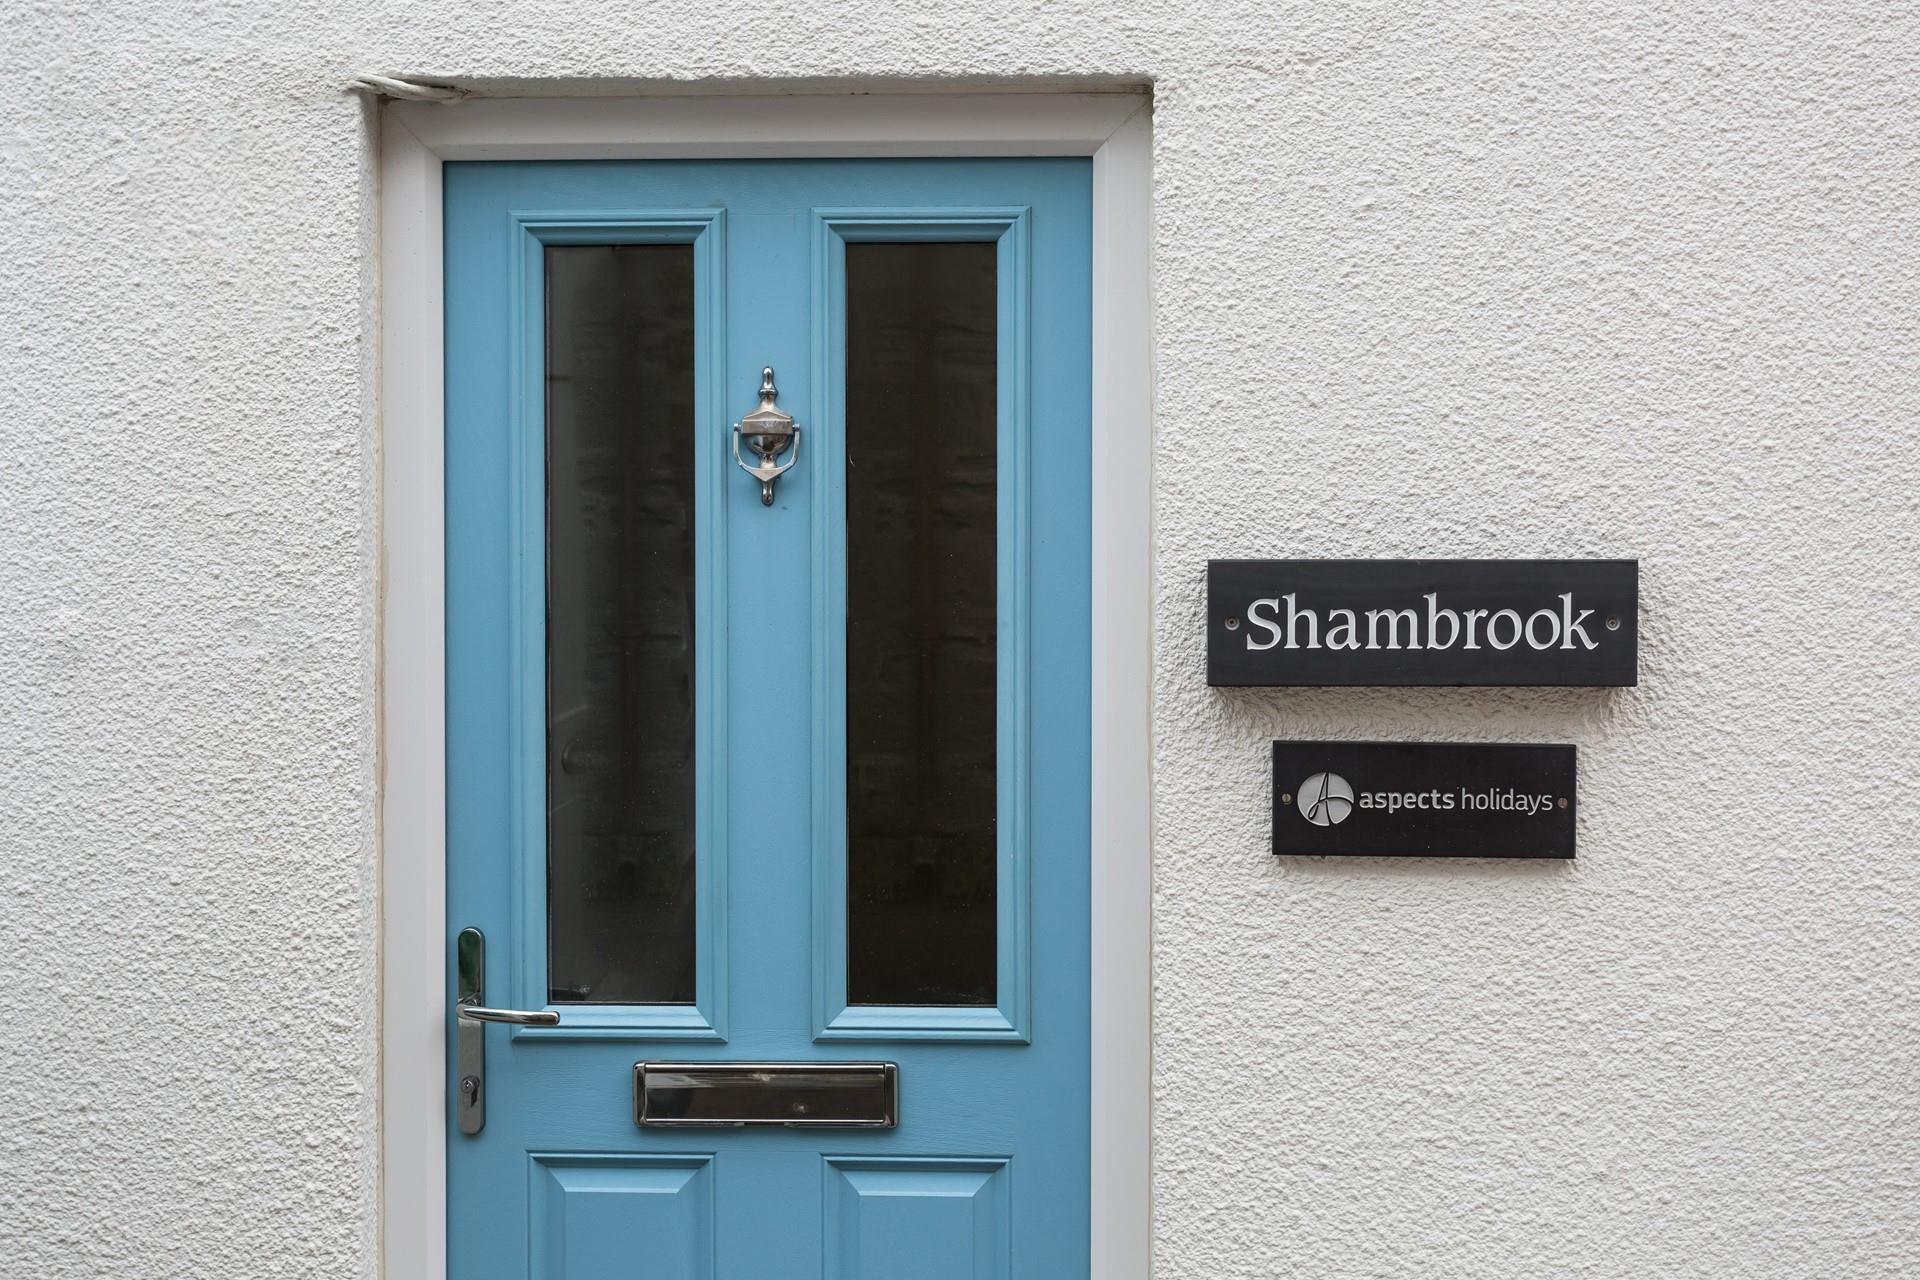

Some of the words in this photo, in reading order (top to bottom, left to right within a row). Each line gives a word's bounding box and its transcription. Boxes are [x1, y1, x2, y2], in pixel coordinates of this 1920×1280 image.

[1245, 591, 1600, 651] Shambrook
[1359, 788, 1455, 814] aspects
[1461, 787, 1553, 816] holidays
